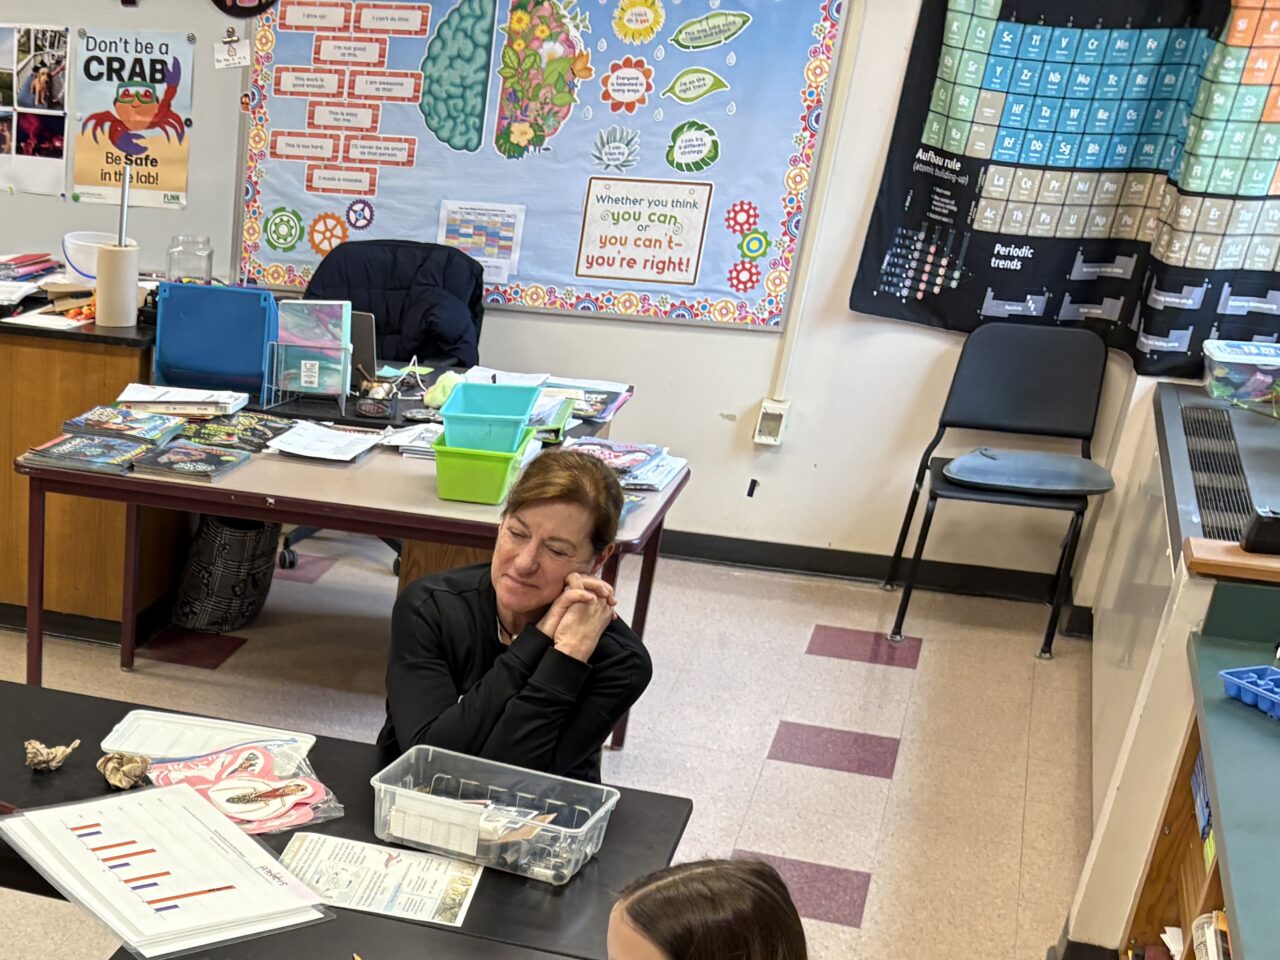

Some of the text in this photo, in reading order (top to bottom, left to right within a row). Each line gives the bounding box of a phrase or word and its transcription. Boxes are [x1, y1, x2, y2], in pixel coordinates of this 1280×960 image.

[1002, 32, 1013, 42] Sc
[1062, 37, 1068, 48] V
[86, 36, 169, 55] Don't be a
[83, 55, 167, 84] CRAB
[996, 66, 1003, 76] Y
[1021, 69, 1031, 80] Zr
[1048, 72, 1061, 82] Nb
[1012, 104, 1024, 114] Hf
[1041, 106, 1051, 116] Ta
[1070, 108, 1080, 119] W
[1003, 137, 1014, 147] Rf
[1030, 140, 1043, 150] Db
[1060, 142, 1071, 155] Sg
[105, 152, 158, 167] Be Safe
[916, 148, 961, 171] Aufbau rule
[100, 169, 111, 181] in
[136, 171, 159, 185] lab!
[993, 174, 1004, 186] La
[1021, 178, 1032, 189] Ce
[1049, 180, 1060, 191] Pr
[595, 194, 699, 209] Whether you think
[611, 210, 677, 226] you can
[984, 208, 997, 219] Ac
[1012, 210, 1023, 221] Th
[1040, 213, 1051, 224] Pa
[1070, 214, 1077, 225] U
[637, 224, 650, 232] or
[599, 234, 628, 249] you
[994, 244, 1034, 258] Periodic
[585, 249, 690, 275] you're right!
[991, 257, 1021, 270] trends
